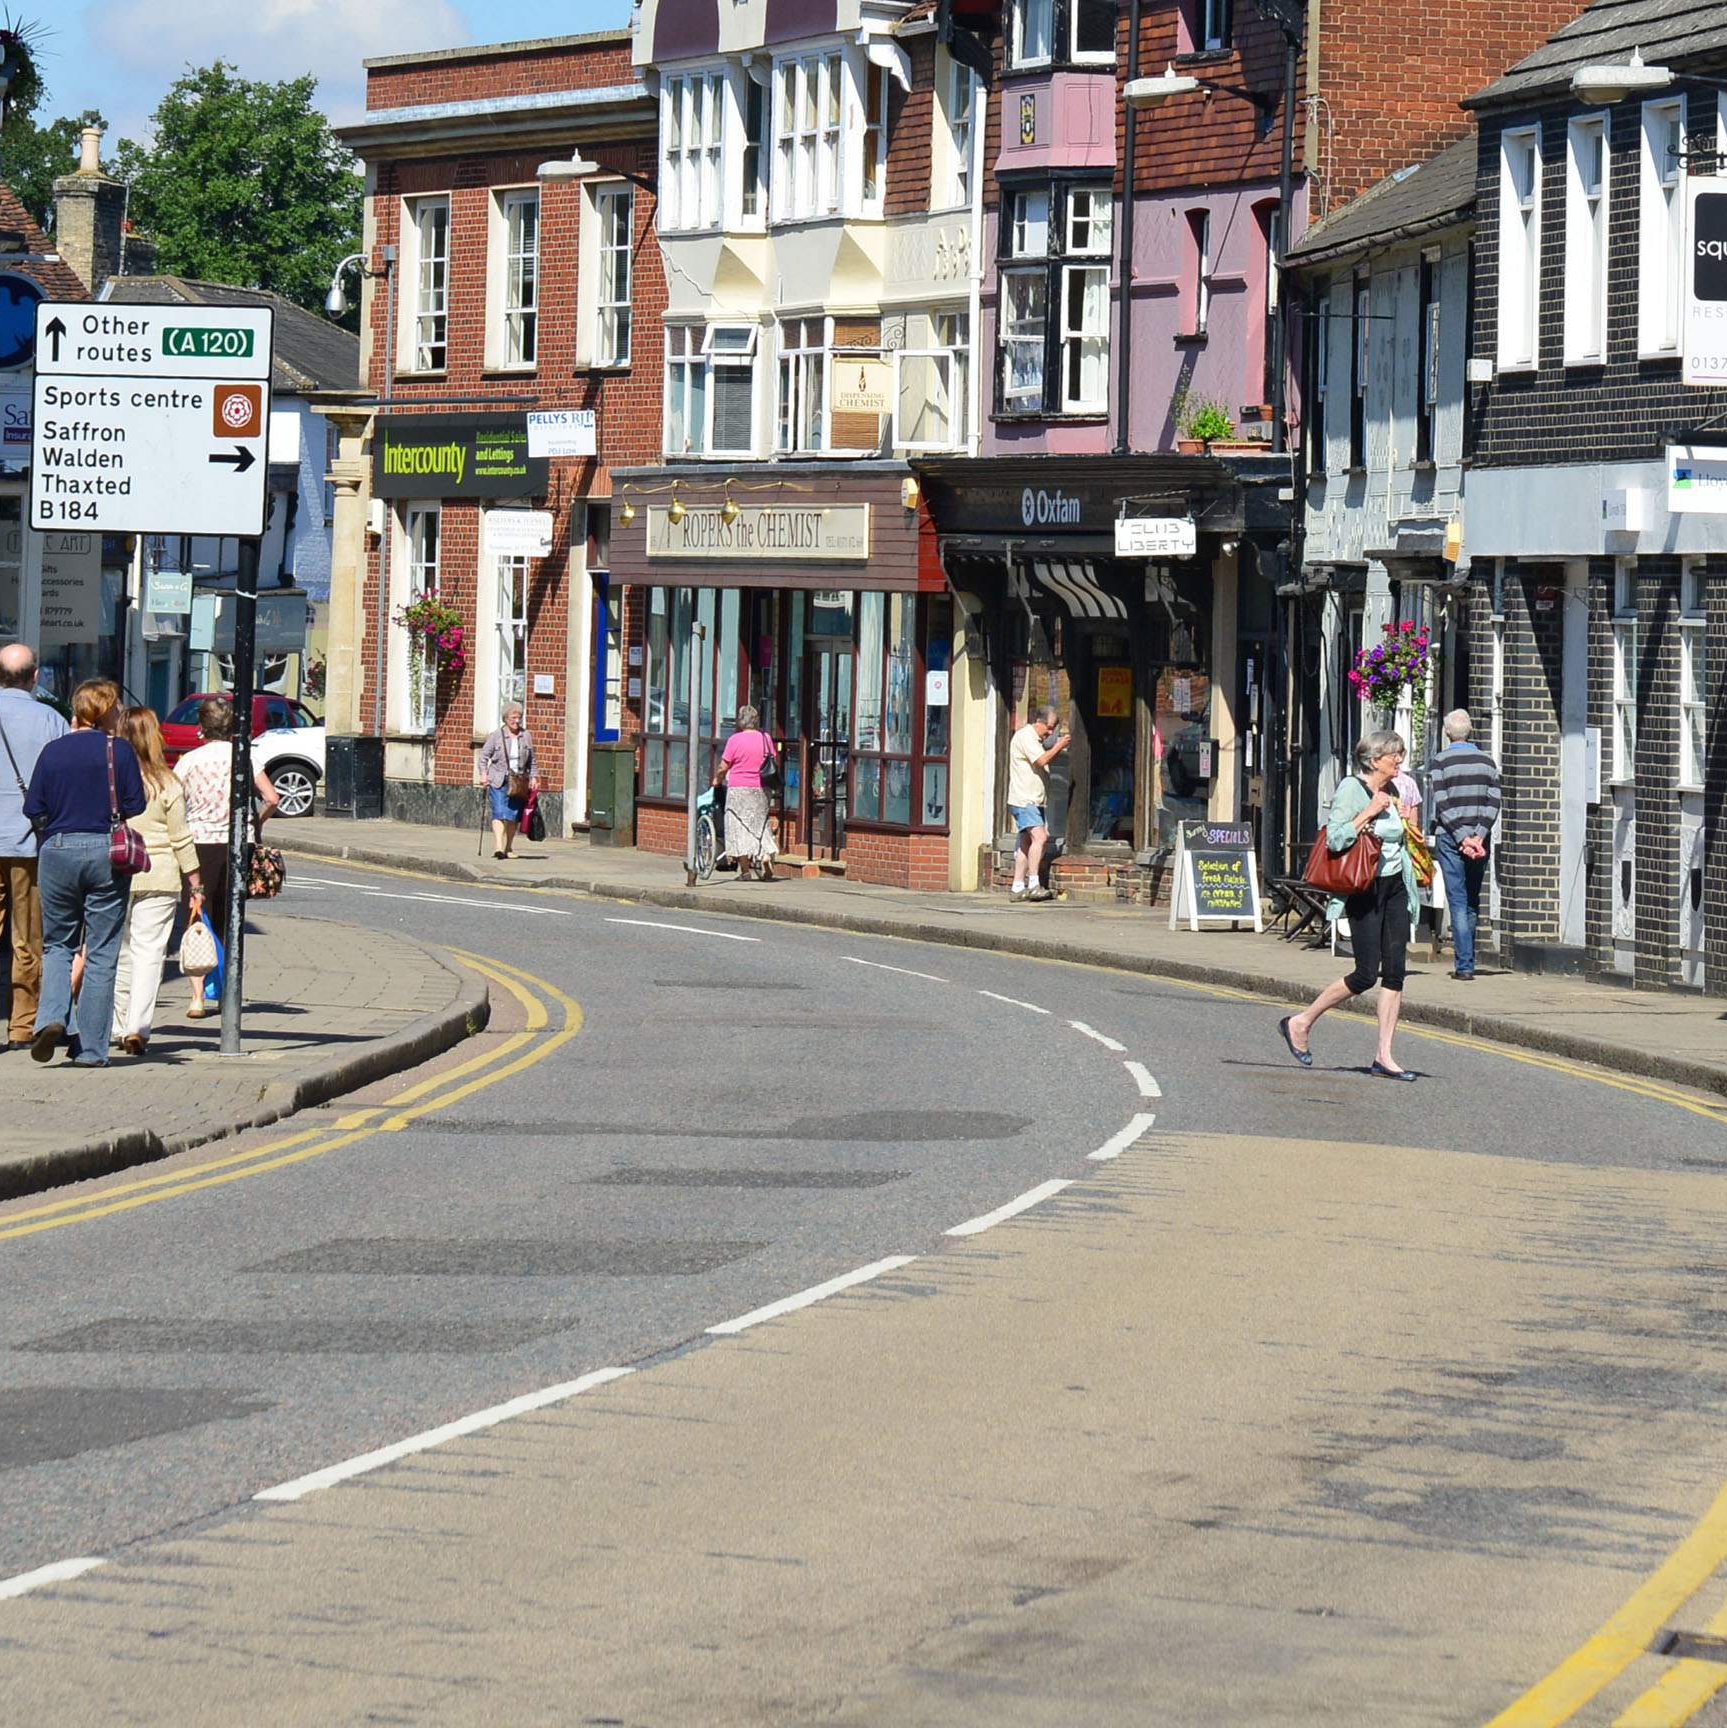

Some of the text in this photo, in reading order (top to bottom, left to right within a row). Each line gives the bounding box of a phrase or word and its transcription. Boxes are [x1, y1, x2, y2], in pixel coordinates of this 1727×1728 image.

[82, 314, 151, 336] Other
[76, 342, 153, 363] routes
[43, 385, 203, 410] Sports centre
[839, 399, 886, 408] CHEMIST
[529, 413, 568, 425] PELLYS
[42, 420, 126, 443] Saffron
[41, 446, 124, 469] Walden
[383, 428, 467, 484] Intercounty
[475, 447, 515, 464] and Lettings
[40, 473, 132, 496] Thaxted
[1036, 488, 1081, 524] Oxfam
[735, 516, 754, 548] the
[756, 512, 823, 549] CHEMIST
[1130, 523, 1181, 535] CLUB
[1117, 539, 1195, 552] LIBERTY
[40, 576, 85, 587] ccessories
